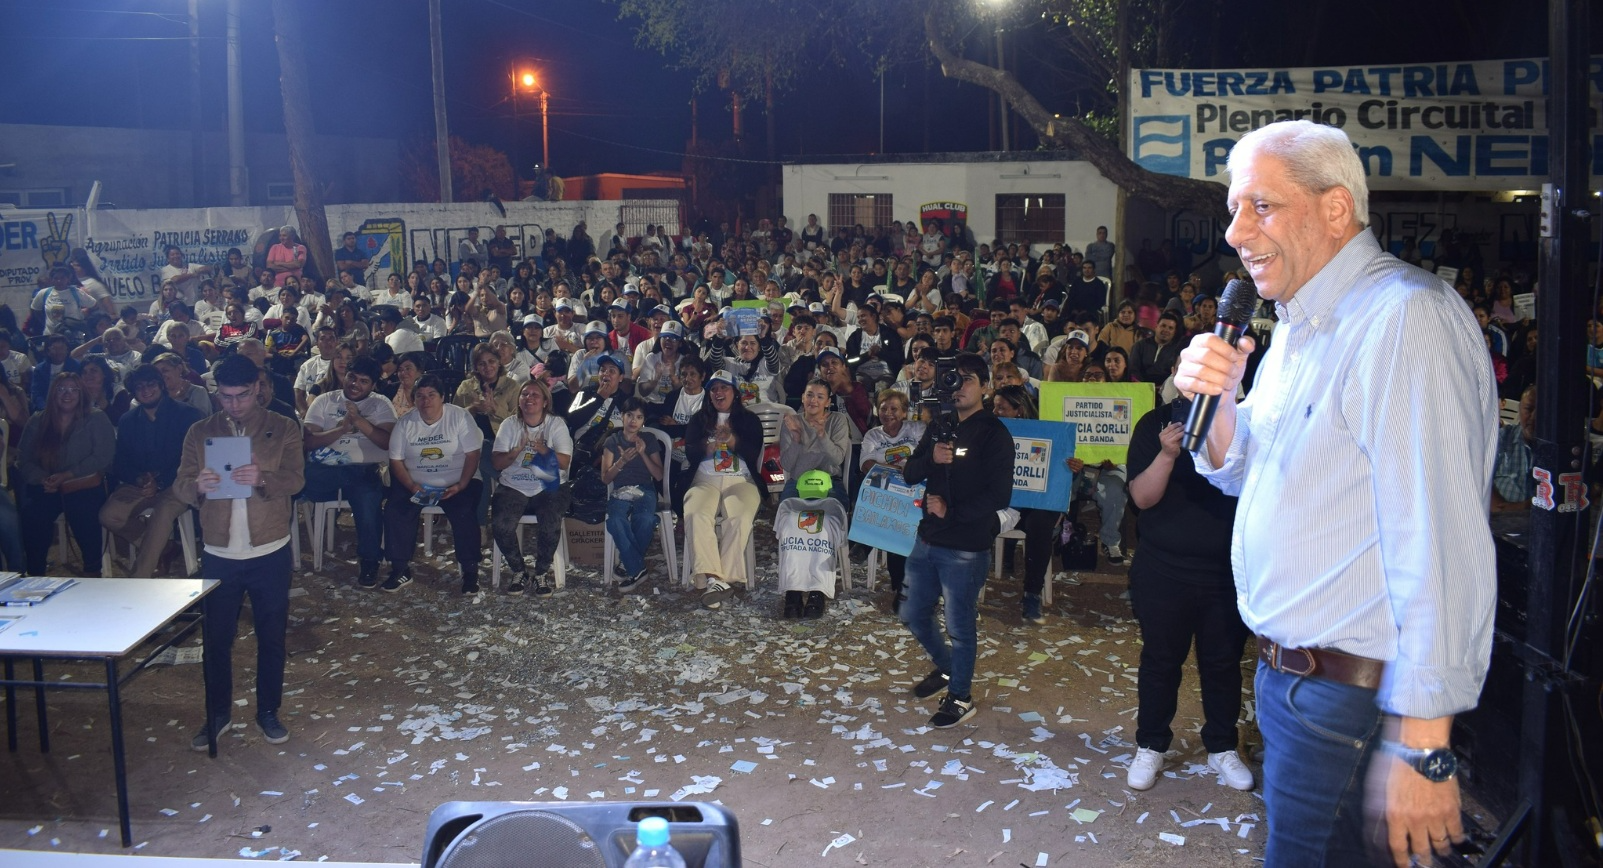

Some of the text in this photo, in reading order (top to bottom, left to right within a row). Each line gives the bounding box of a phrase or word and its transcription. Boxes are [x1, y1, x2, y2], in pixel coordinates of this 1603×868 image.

[1140, 69, 1297, 98] FUERZA
[1312, 64, 1481, 97] PATRIA
[1356, 99, 1534, 130] Circuital
[921, 203, 966, 212] HUAL CLUB
[0, 221, 39, 250] ER
[153, 230, 201, 248] PATRICIA
[202, 228, 249, 246] SERRANO
[104, 275, 145, 297] UECO
[1075, 401, 1104, 410] PARTIDO
[1065, 410, 1113, 418] JUSTICIALISTA
[1077, 422, 1129, 434] CIA CORLLI
[417, 433, 443, 443] NEDER
[1089, 435, 1115, 443] BANDA
[1013, 465, 1046, 479] ORLLI
